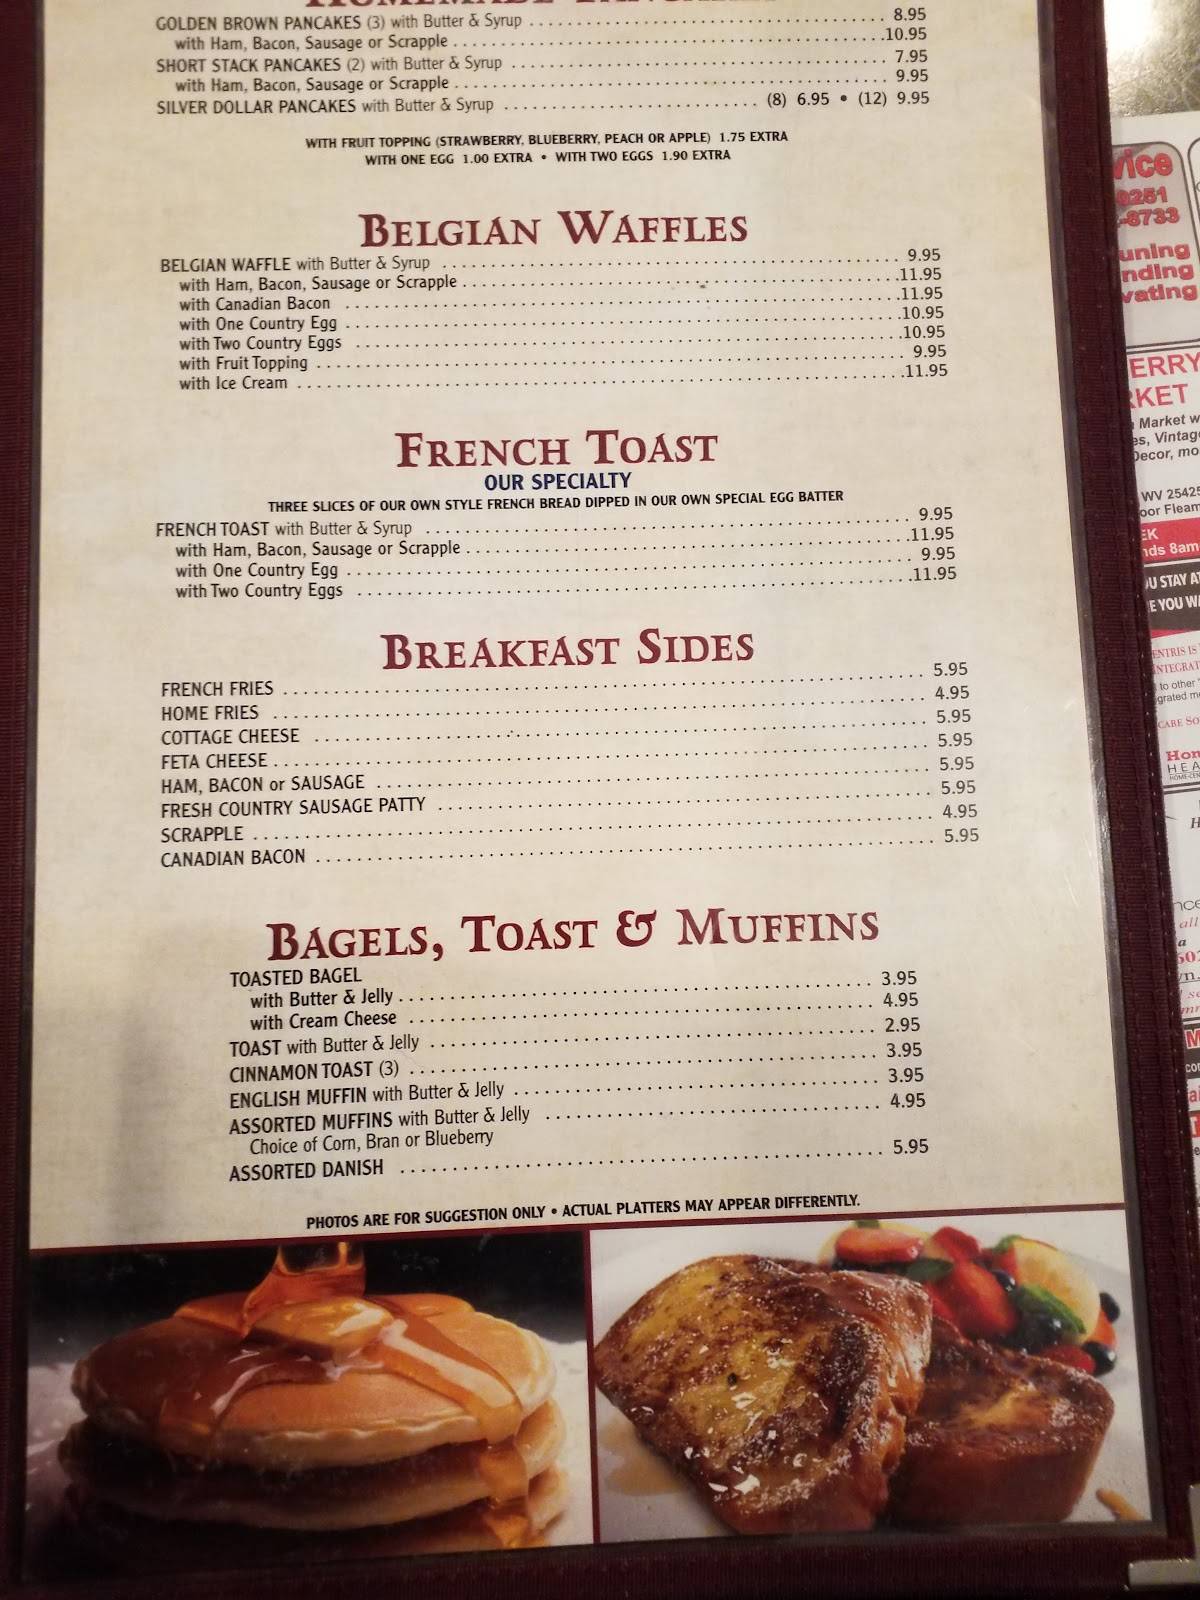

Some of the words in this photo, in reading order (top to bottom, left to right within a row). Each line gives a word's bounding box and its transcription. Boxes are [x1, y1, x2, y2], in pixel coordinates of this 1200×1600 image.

[156, 16, 217, 31] GOLDEN
[223, 16, 278, 31] BROWN
[284, 15, 361, 30] PANCAKES
[367, 16, 385, 30] (3)
[391, 15, 418, 29] with
[424, 13, 464, 27] Butter
[469, 13, 479, 27] &
[485, 13, 522, 29] Syrup
[894, 7, 926, 21] 8.95
[175, 36, 204, 50] with
[211, 36, 247, 51] Ham,
[253, 36, 299, 51] Bacon,
[305, 35, 362, 52] Sausage
[368, 39, 383, 48] or
[388, 33, 447, 50] Scrapple
[887, 27, 927, 41] 10.95
[157, 100, 207, 114] SILVER
[213, 100, 273, 114] DOLLAR
[279, 98, 356, 113] PANCAKES
[362, 99, 389, 112] with
[395, 98, 435, 112] Butter
[440, 98, 451, 112] &
[457, 97, 493, 113] Syrup
[767, 93, 786, 108] (8)
[797, 92, 829, 105] 6.95
[859, 92, 887, 108] (12)
[897, 91, 929, 104] 9.95
[306, 138, 336, 148] WITH
[342, 137, 375, 147] FRUIT
[379, 136, 431, 147] TOPPING
[436, 135, 524, 148] (STRAWBERRY,
[528, 134, 600, 145] BLUEBERRY,
[605, 133, 643, 144] PEACH
[648, 133, 664, 143] OR
[669, 133, 710, 144] APPLE)
[720, 132, 745, 142] 1.75
[750, 131, 788, 142] EXTRA
[179, 356, 210, 370] with
[216, 356, 249, 369] Fruit
[252, 356, 307, 373] Topping
[914, 344, 946, 358] 9.95
[179, 376, 210, 390] with
[216, 375, 236, 389] Ice
[242, 376, 287, 389] Cream
[906, 363, 948, 377] 11.95
[1139, 414, 1186, 429] Market
[485, 474, 523, 490] OUR
[532, 472, 631, 490] SPECIALTY
[268, 501, 308, 512] THREE
[313, 501, 355, 512] SLICES
[359, 500, 375, 511] OF
[380, 500, 406, 511] OUR
[410, 499, 440, 511] OWN
[445, 499, 482, 510] STYLE
[488, 498, 534, 509] FRENCH
[540, 498, 580, 508] BREAD
[586, 497, 630, 507] DIPPED
[635, 495, 646, 507] IN
[651, 495, 676, 506] OUR
[681, 494, 710, 506] OWN
[716, 492, 765, 504] SPECIAL
[770, 492, 793, 503] EGG
[799, 491, 843, 502] BATTER
[1141, 490, 1163, 502] WV
[176, 564, 206, 578] with
[213, 563, 242, 578] One
[248, 562, 304, 580] Country
[312, 562, 338, 580] Egg
[922, 546, 955, 561] 9.95
[1161, 573, 1188, 589] STAY
[1158, 596, 1184, 612] YOU
[162, 681, 223, 697] FRENCH
[230, 680, 273, 696] FRIES
[934, 662, 968, 677] 5.95
[1160, 683, 1169, 691] to
[1172, 679, 1195, 690] other
[162, 778, 202, 795] HAM,
[209, 777, 262, 793] BACON
[270, 780, 285, 791] or
[292, 774, 364, 791] SAUSAGE
[940, 756, 974, 771] 5.95
[162, 803, 212, 818] FRESH
[219, 800, 293, 816] COUNTRY
[300, 798, 373, 814] SAUSAGE
[379, 796, 425, 812] PATTY
[942, 780, 976, 795] 5.95
[616, 910, 657, 947] &
[230, 970, 303, 987] TOASTED
[310, 968, 362, 984] BAGEL
[250, 993, 283, 1008] with
[290, 992, 338, 1007] Butter
[343, 989, 355, 1004] &
[361, 988, 393, 1006] Jelly
[882, 971, 917, 986] 3.95
[250, 1014, 283, 1030] with
[289, 1013, 338, 1029] Cream
[344, 1011, 396, 1026] Cheese
[883, 992, 918, 1007] 4.95
[230, 1064, 317, 1083] CINNAMON
[322, 1061, 373, 1079] TOAST
[379, 1060, 399, 1078] (3)
[887, 1042, 922, 1058] 3.95
[250, 1138, 297, 1154] Choice
[303, 1136, 318, 1152] of
[323, 1135, 360, 1152] Corn,
[367, 1133, 399, 1149] Bran
[405, 1135, 420, 1147] or
[426, 1129, 493, 1146] Blueberry
[229, 1162, 316, 1182] ASSORTED
[323, 1158, 383, 1177] DANISH
[894, 1138, 928, 1155] 5.95
[307, 1214, 358, 1228] PHOTOS
[363, 1213, 389, 1226] ARE
[395, 1212, 420, 1225] FOR
[425, 1208, 507, 1223] SUGGESTION
[512, 1205, 546, 1218] ONLY
[563, 1203, 612, 1216] ACTUAL
[617, 1201, 680, 1214] PLATTERS
[685, 1199, 713, 1212] MAY
[718, 1197, 770, 1211] APPEAR
[775, 1194, 860, 1208] DIFFERENTLY.
